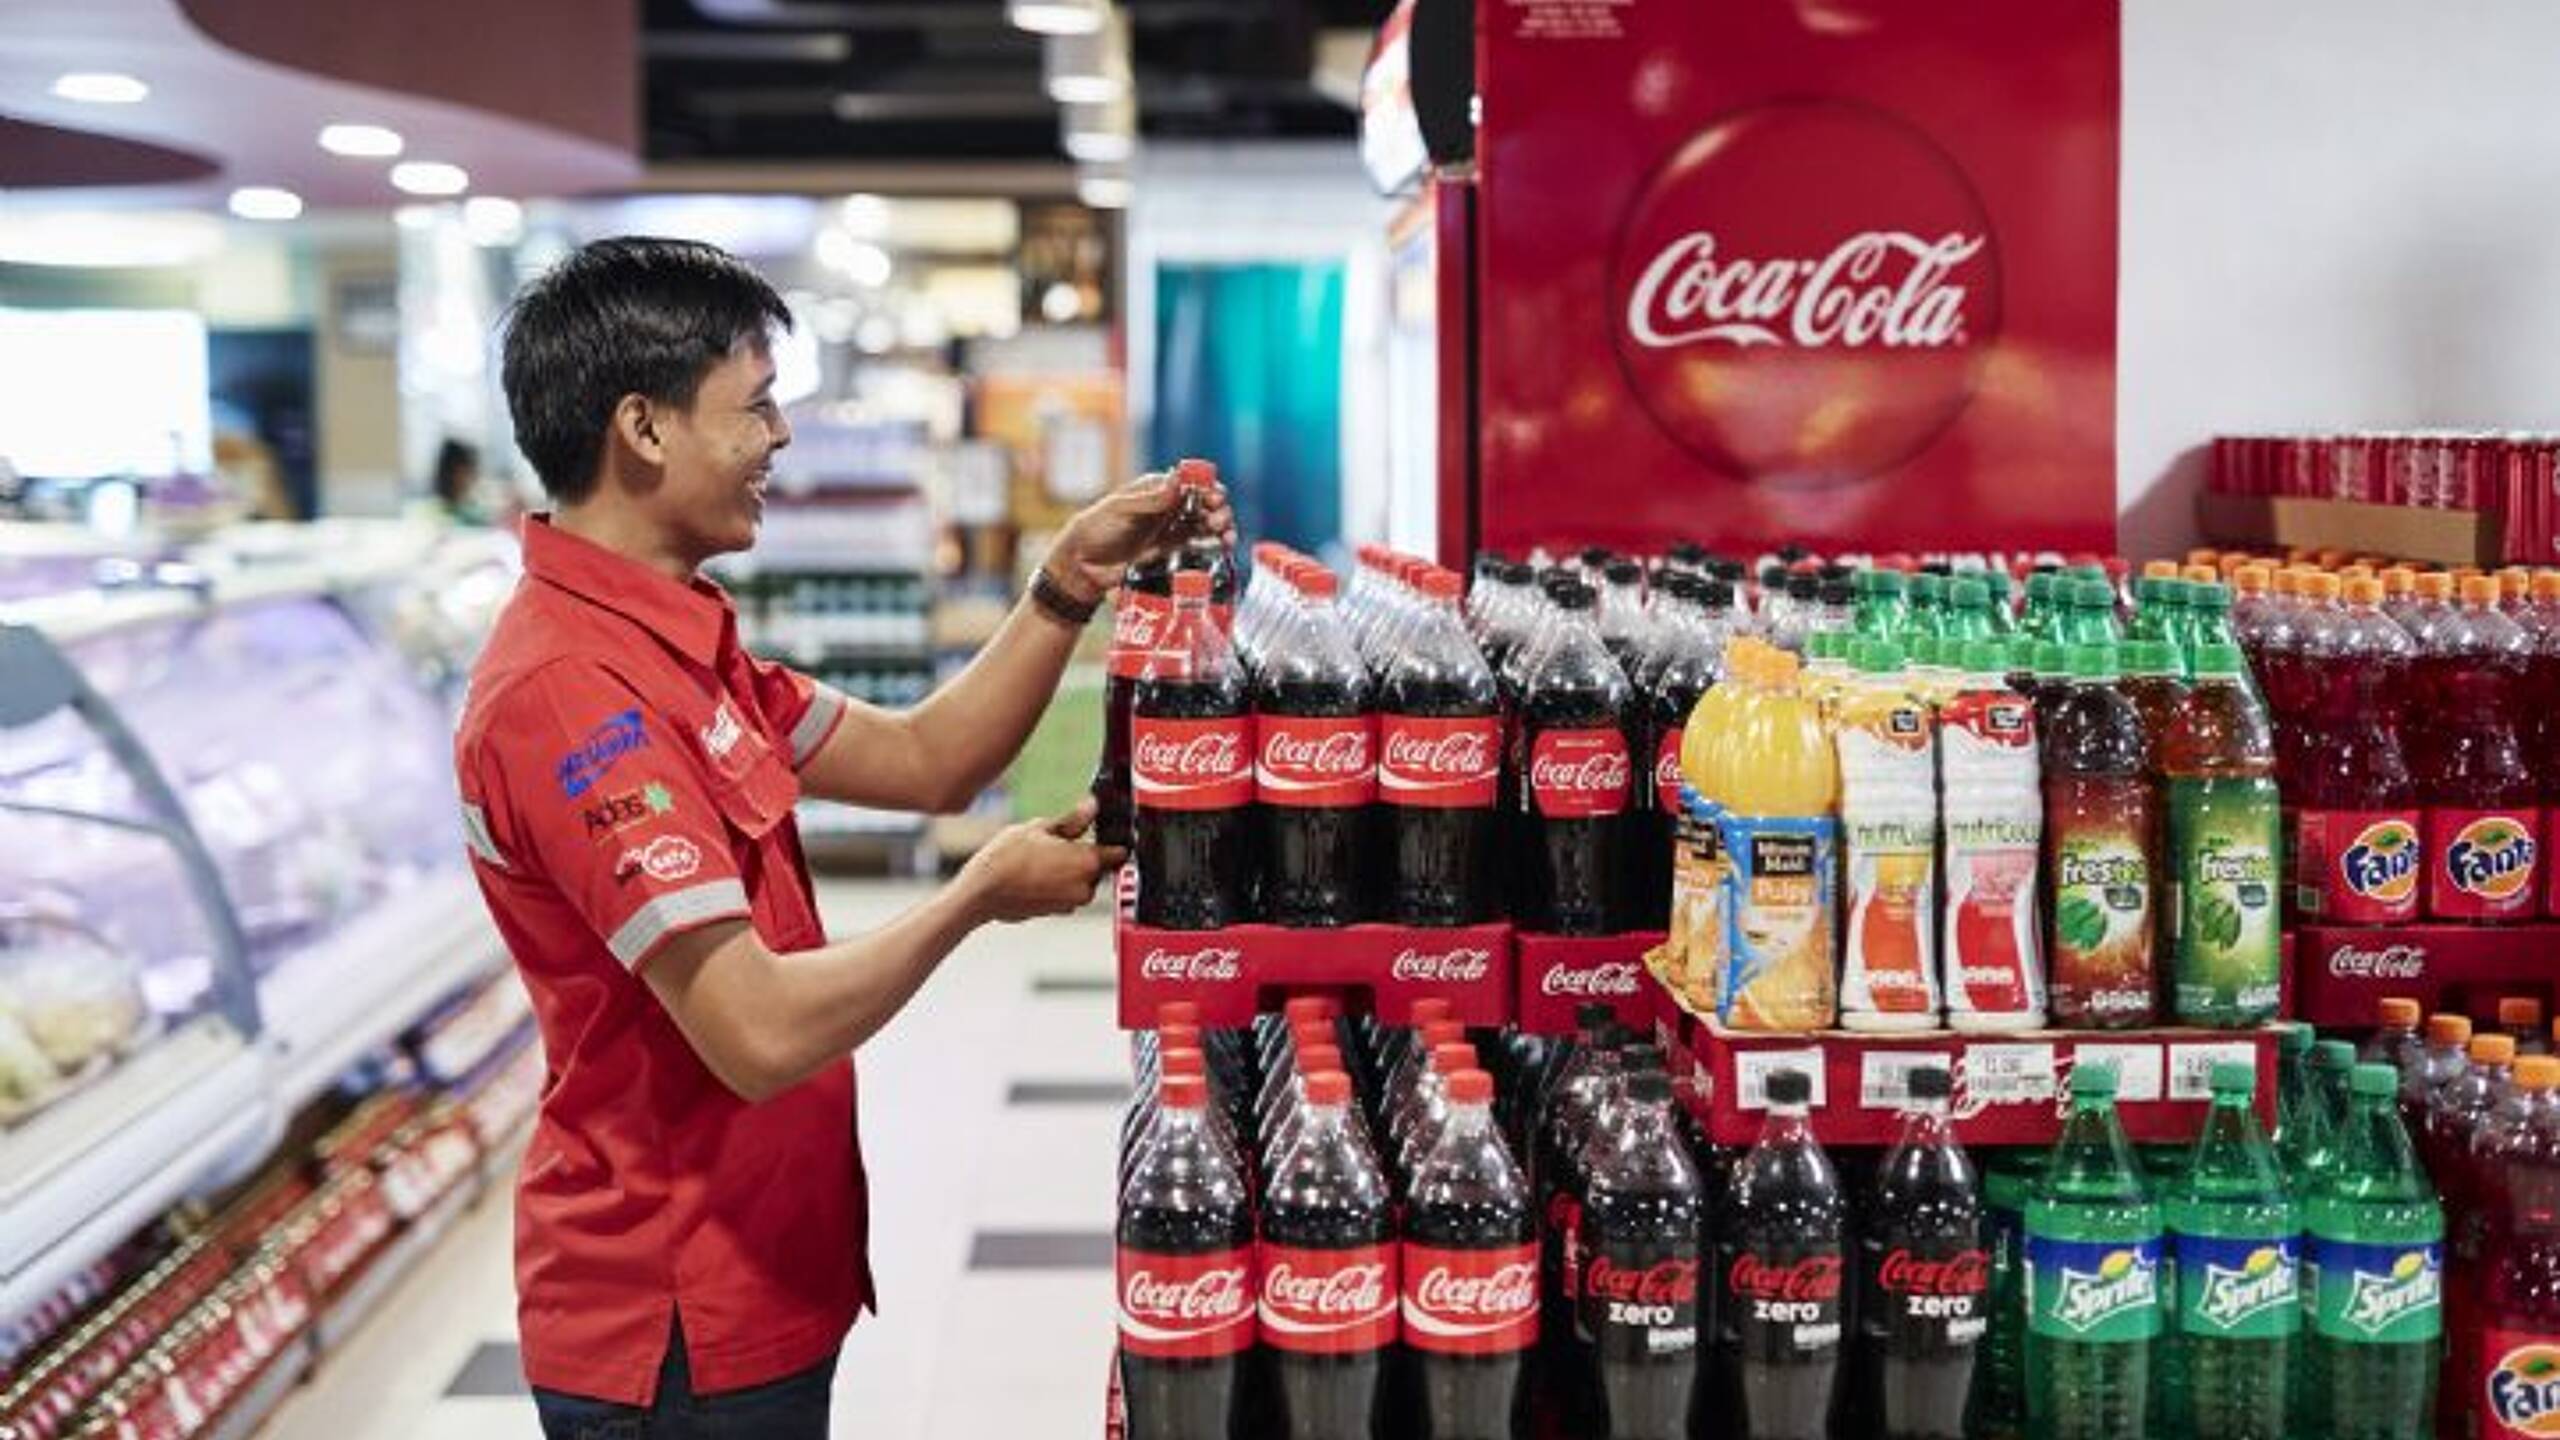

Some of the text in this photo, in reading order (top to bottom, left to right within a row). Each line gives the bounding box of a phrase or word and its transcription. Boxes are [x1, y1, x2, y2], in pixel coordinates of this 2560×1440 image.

[1628, 231, 1985, 348] Coca-Cola
[1135, 731, 1243, 775] Coca-Cola
[1264, 731, 1369, 773] Coca-Cola
[1385, 731, 1488, 774] Coca-Cola
[1531, 752, 1628, 791] Coca-Cola
[2345, 839, 2419, 891] Fant
[1140, 949, 1243, 981] Coca-Cola
[1392, 949, 1489, 981] Coca-Cola
[1542, 963, 1642, 996] Coca-Cola
[1126, 1267, 1246, 1319] Coca-Cola
[1265, 1262, 1384, 1313] Coca-Cola
[1418, 1259, 1537, 1312] Coca-Cola
[1907, 1296, 1972, 1317] zero
[1609, 1302, 1675, 1326] zero
[1754, 1300, 1820, 1322] zero
[2491, 1369, 2560, 1422] Fan
